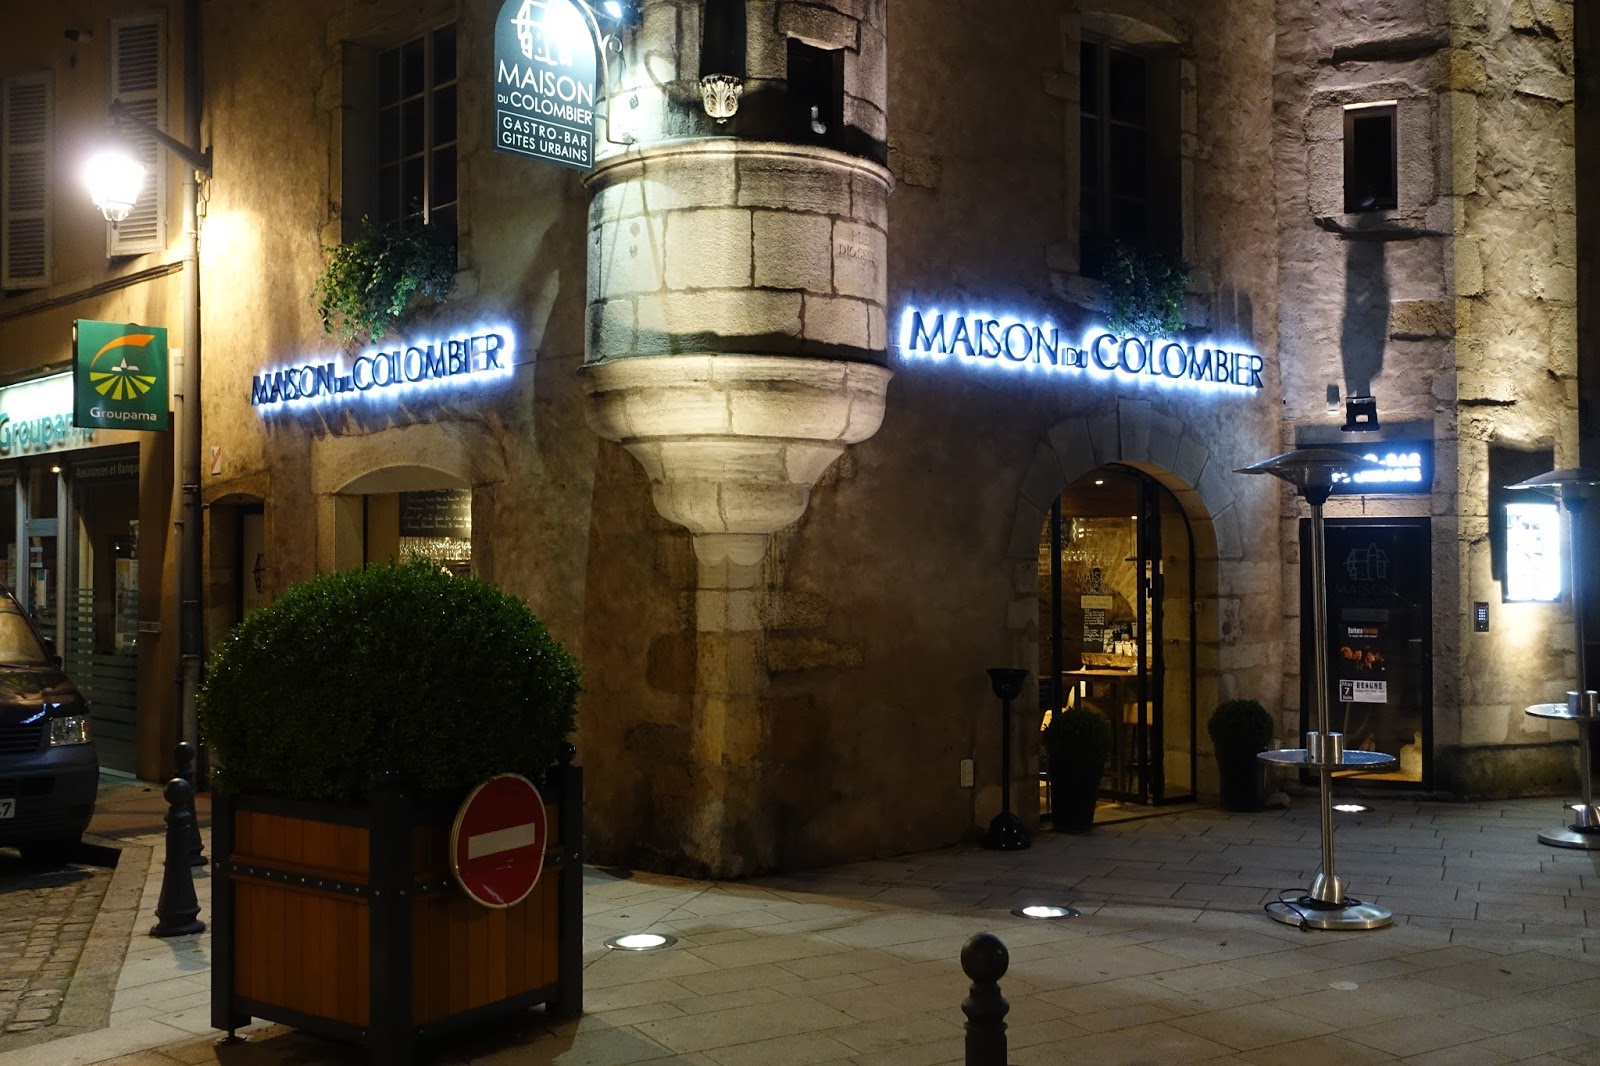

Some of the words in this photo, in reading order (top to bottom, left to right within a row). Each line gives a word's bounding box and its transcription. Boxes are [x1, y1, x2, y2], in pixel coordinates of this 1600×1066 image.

[497, 59, 593, 107] MAISON
[497, 93, 509, 104] DU
[510, 91, 593, 126] COLOMBIER
[502, 131, 536, 150] GITES
[539, 140, 588, 162] URBAINS
[908, 310, 1059, 366] MAISON
[1062, 347, 1088, 369] DU
[1091, 333, 1264, 388] COLOMBIER
[251, 362, 335, 406] MAISON
[352, 333, 505, 390] COLOMBIER
[89, 406, 157, 422] Groupama
[109, 464, 117, 476] et
[117, 462, 139, 477] Banqu
[1344, 687, 1351, 695] 7
[1356, 682, 1383, 690] BEAUNE
